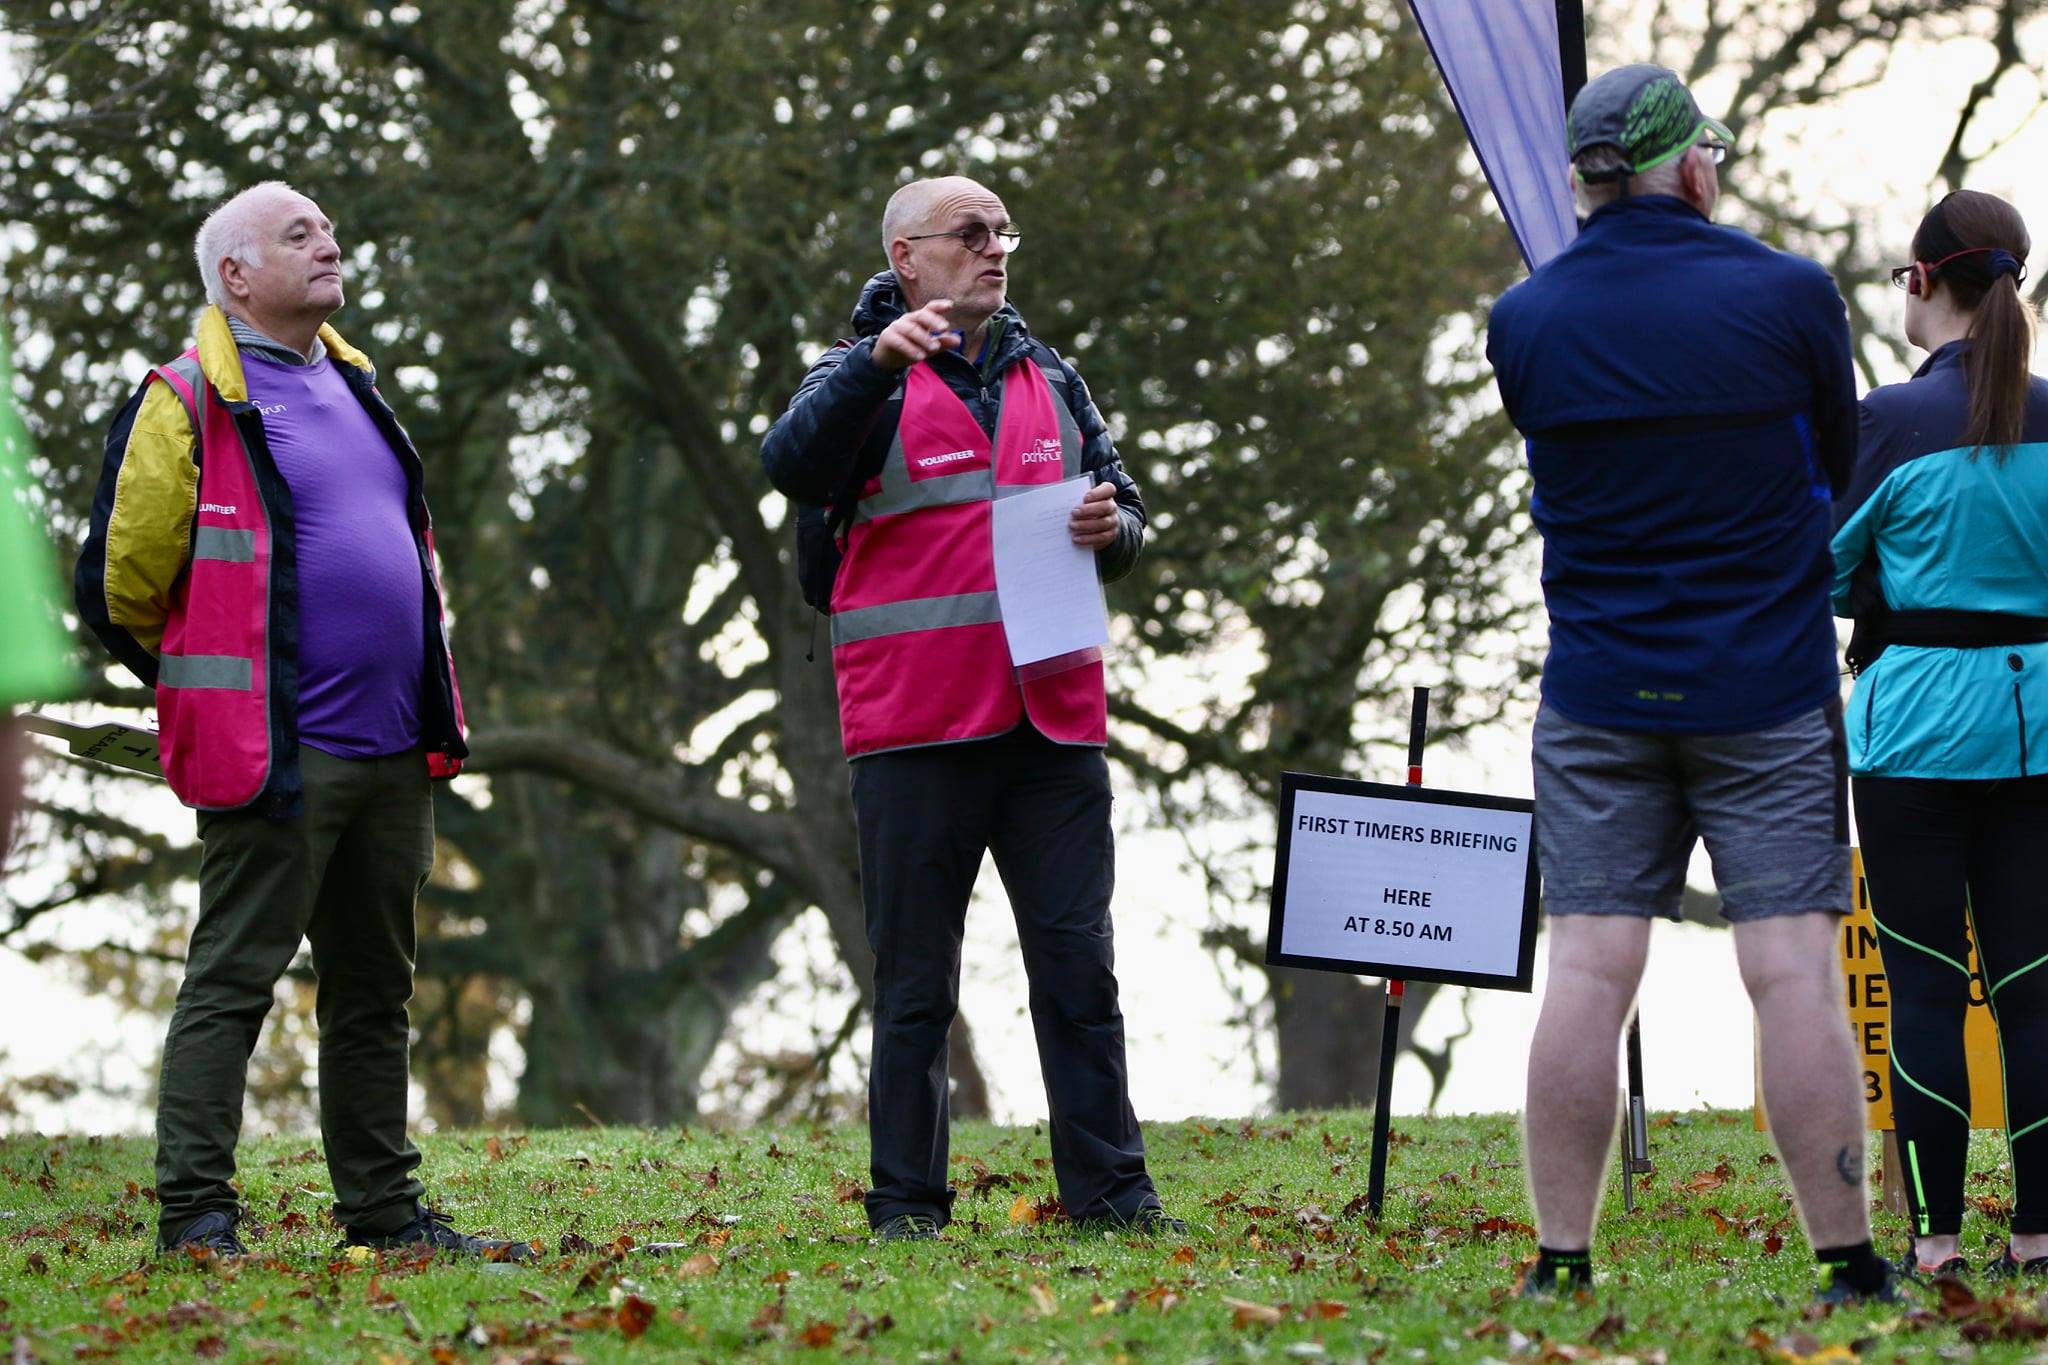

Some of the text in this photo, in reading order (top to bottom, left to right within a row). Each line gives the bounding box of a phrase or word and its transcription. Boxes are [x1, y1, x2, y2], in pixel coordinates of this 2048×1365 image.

[917, 449, 976, 467] VOLUNTEER
[199, 503, 237, 515] LUNTEER
[82, 727, 130, 758] PLEASE
[1298, 815, 1518, 853] FIRST TIMERS BRIEFING
[1383, 887, 1432, 907] HERE
[1343, 916, 1453, 942] AT 8.50 AM
